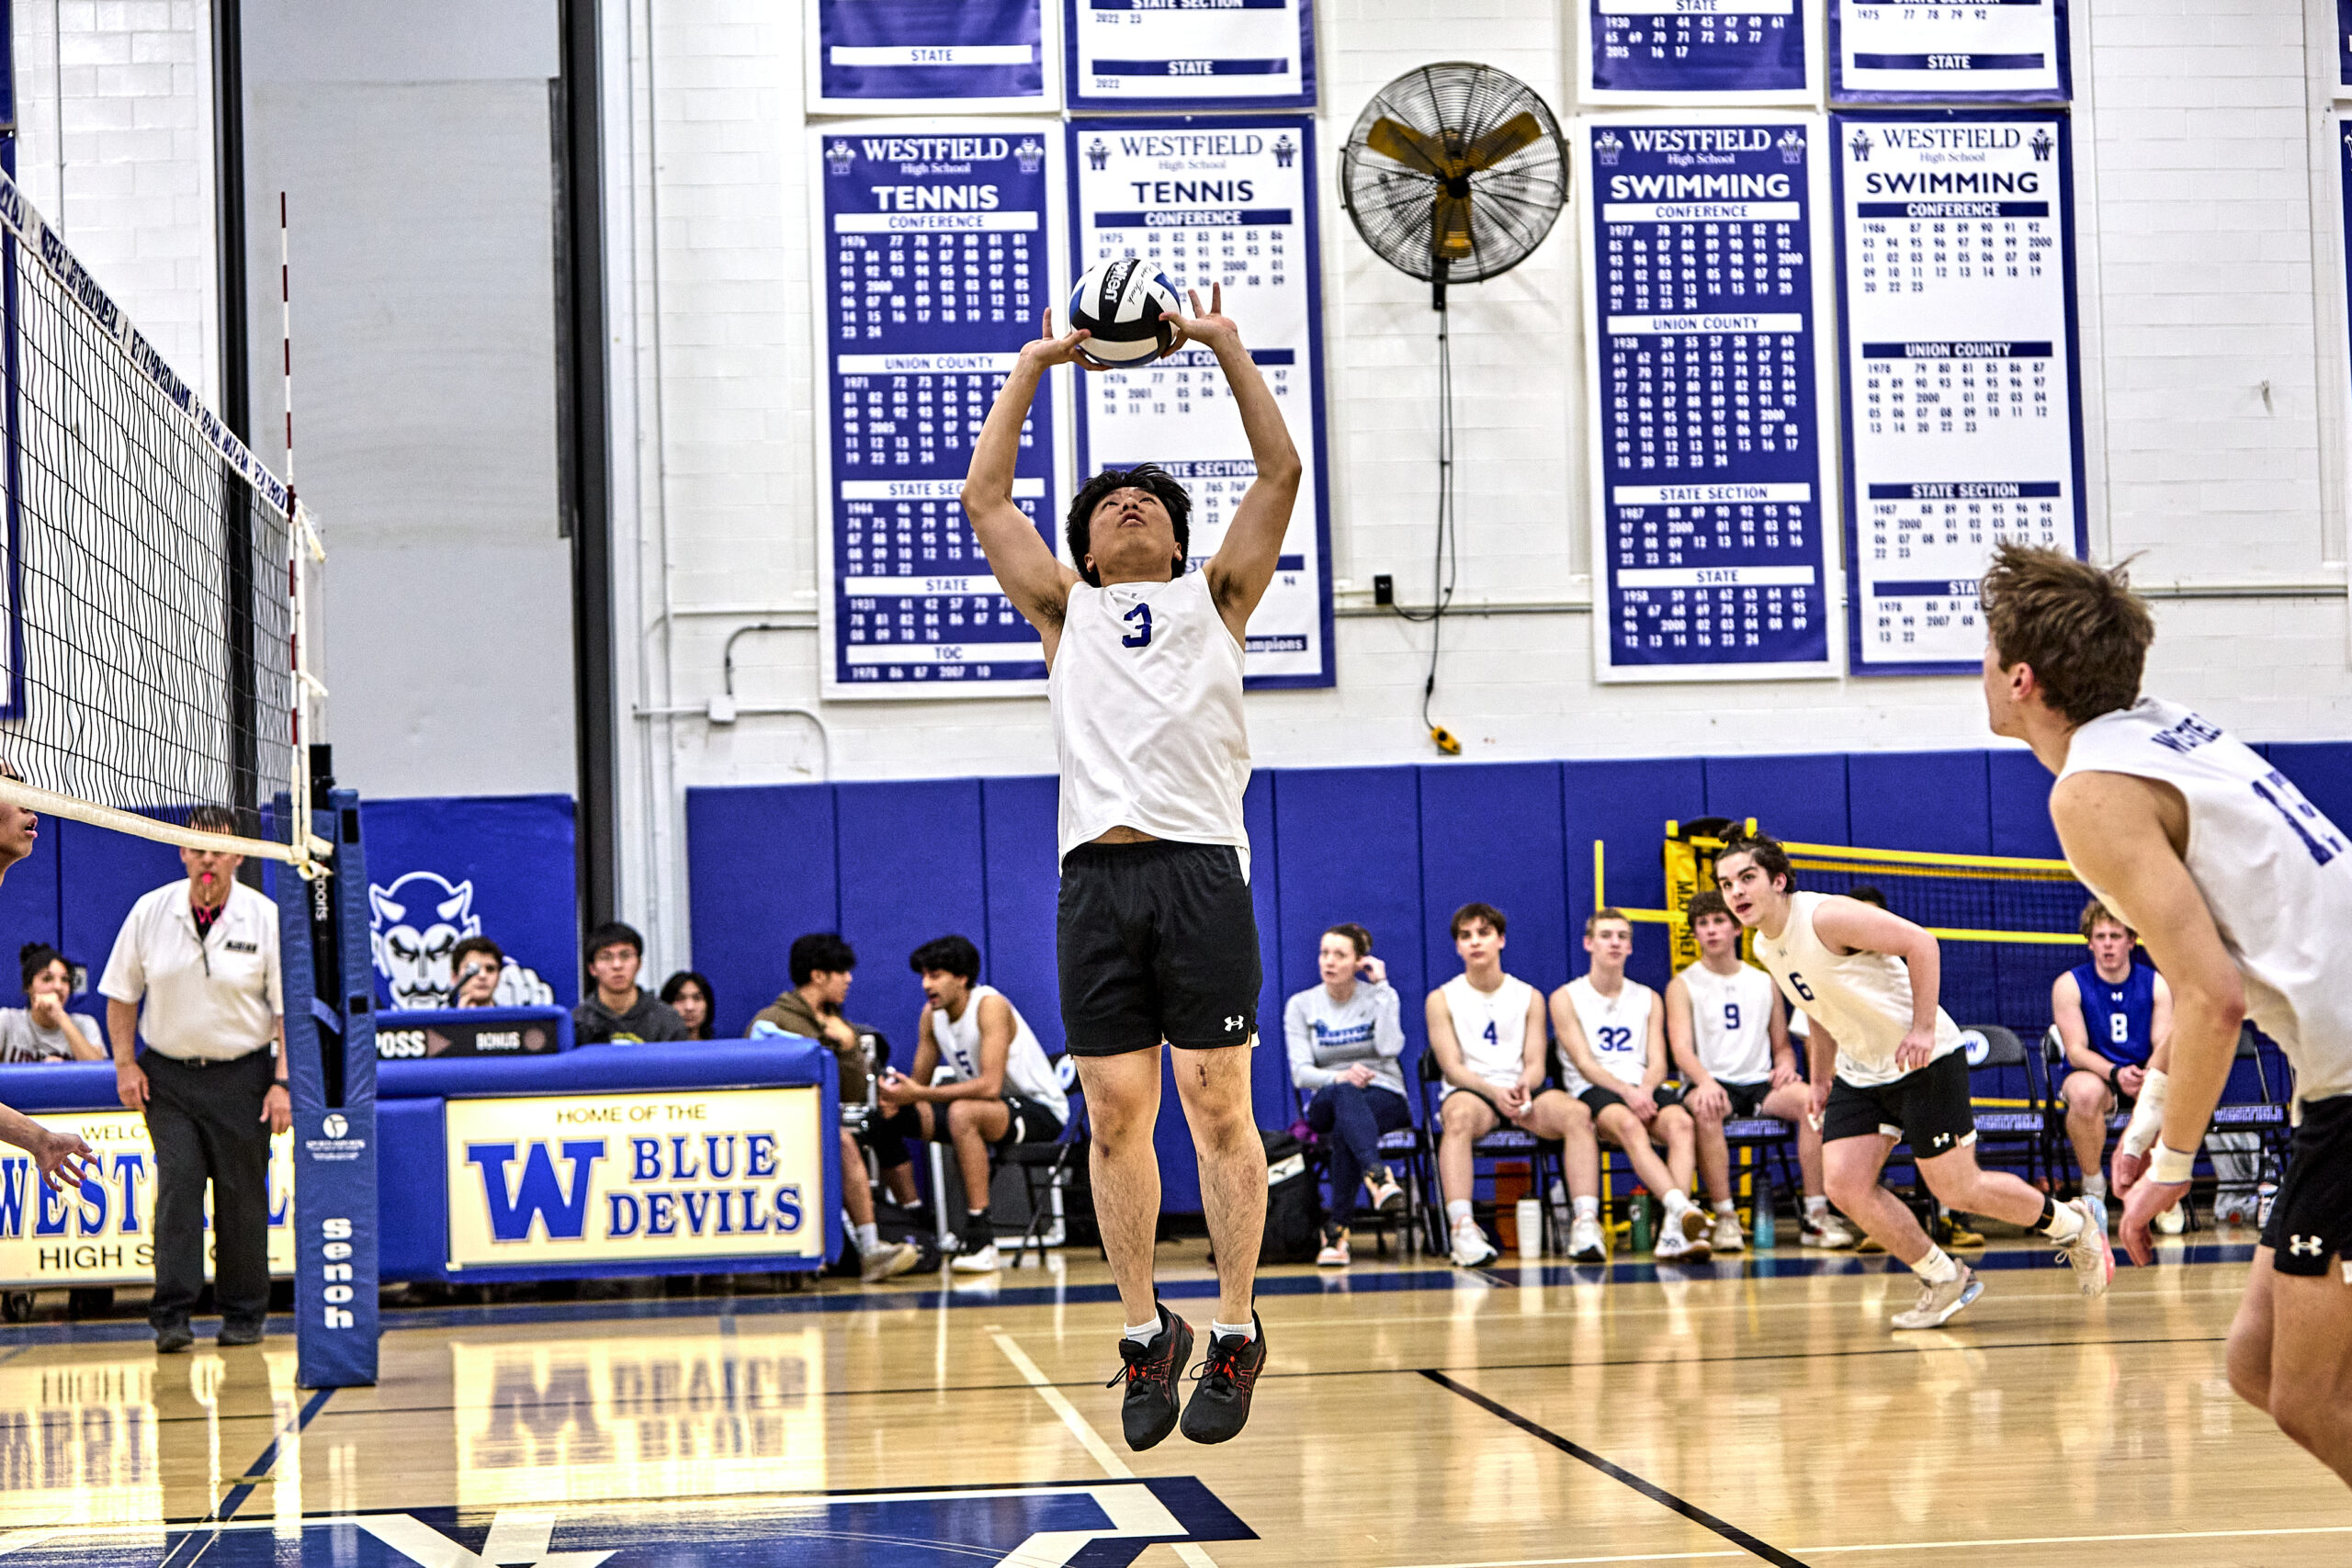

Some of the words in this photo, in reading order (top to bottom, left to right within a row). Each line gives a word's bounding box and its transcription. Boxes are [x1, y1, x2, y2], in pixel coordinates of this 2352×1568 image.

[1676, 0, 1717, 11] STATE
[1904, 8, 1916, 20] 77
[1927, 8, 1939, 20] 78
[1951, 8, 1963, 19] 79
[1973, 8, 1987, 20] 92
[1604, 30, 1619, 44] 65
[1628, 30, 1644, 44] 69
[1652, 30, 1668, 44] 70
[1677, 30, 1690, 43] 71
[1701, 30, 1715, 44] 72
[1724, 30, 1739, 44] 76
[1748, 30, 1762, 43] 77
[910, 49, 953, 62] STATE
[1651, 46, 1665, 59] 16
[1675, 45, 1689, 58] 17
[1168, 61, 1213, 74] STATE
[1928, 54, 1972, 69] STATE
[1120, 134, 1263, 157] WESTFIELD
[1629, 129, 1772, 152] WESTFIELD
[1883, 128, 2021, 149] WESTFIELD
[861, 137, 1010, 162] WESTFIELD
[1668, 152, 1695, 166] High
[1697, 151, 1736, 164] School
[1919, 152, 1947, 165] High
[1948, 150, 1986, 163] School
[899, 162, 930, 177] High
[931, 161, 972, 175] School
[1158, 160, 1186, 173] High
[1187, 159, 1227, 170] School
[1610, 173, 1791, 200] SWIMMING
[1866, 171, 2039, 195] SWIMMING
[870, 184, 1000, 211] TENNIS
[1130, 179, 1254, 204] TENNIS
[1145, 210, 1241, 226] CONFERENCE
[1656, 205, 1747, 219] CONFERENCE
[1907, 203, 2001, 218] CONFERENCE
[888, 215, 983, 229] CONFERENCE
[1909, 222, 1922, 233] 87
[1933, 222, 1946, 233] 88
[1956, 222, 1970, 233] 89
[1980, 221, 1994, 233] 90
[2004, 221, 2016, 233] 91
[2027, 221, 2041, 233] 92
[1862, 237, 1875, 249] 93
[1885, 237, 1899, 248] 94
[1910, 237, 1923, 248] 95
[1933, 237, 1947, 249] 96
[1957, 236, 1970, 247] 97
[1981, 236, 1994, 248] 98
[2004, 236, 2018, 247] 99
[1862, 252, 1874, 264] 01
[1886, 252, 1899, 264] 02
[1910, 252, 1924, 264] 03
[1933, 252, 1947, 263] 04
[1957, 251, 1971, 263] 05
[1981, 251, 1995, 263] 06
[2005, 251, 2018, 263] 07
[2028, 251, 2041, 263] 08
[1653, 318, 1698, 331] UNION
[1702, 316, 1758, 330] COUNTY
[1905, 344, 1951, 357] UNION
[1954, 343, 2012, 356] COUNTY
[885, 357, 931, 370] UNION
[936, 355, 993, 369] COUNTY
[888, 483, 932, 496] STATE
[1659, 487, 1701, 502] STATE
[1707, 486, 1768, 500] SECTION
[1912, 484, 1956, 498] STATE
[1958, 483, 2019, 497] SECTION
[1696, 570, 1738, 583] STATE
[925, 578, 968, 592] STATE
[1948, 581, 1977, 595] STA
[1122, 603, 1152, 649] 3
[1246, 636, 1304, 653] ampions
[933, 645, 963, 660] TOC
[1790, 971, 1815, 1001] 6
[1724, 1003, 1741, 1031] 9
[1483, 1020, 1498, 1046] 4
[2109, 1012, 2129, 1043] 8
[476, 1031, 521, 1051] BONUS
[1598, 1026, 1634, 1053] 32
[558, 1108, 621, 1124] HOME
[629, 1106, 660, 1122] OF
[667, 1103, 707, 1121] THE
[82, 1124, 148, 1140] WELC
[628, 1132, 779, 1182] BLUE
[464, 1137, 610, 1244] W
[605, 1184, 804, 1239] DEVILS
[40, 1246, 122, 1269] HIGH
